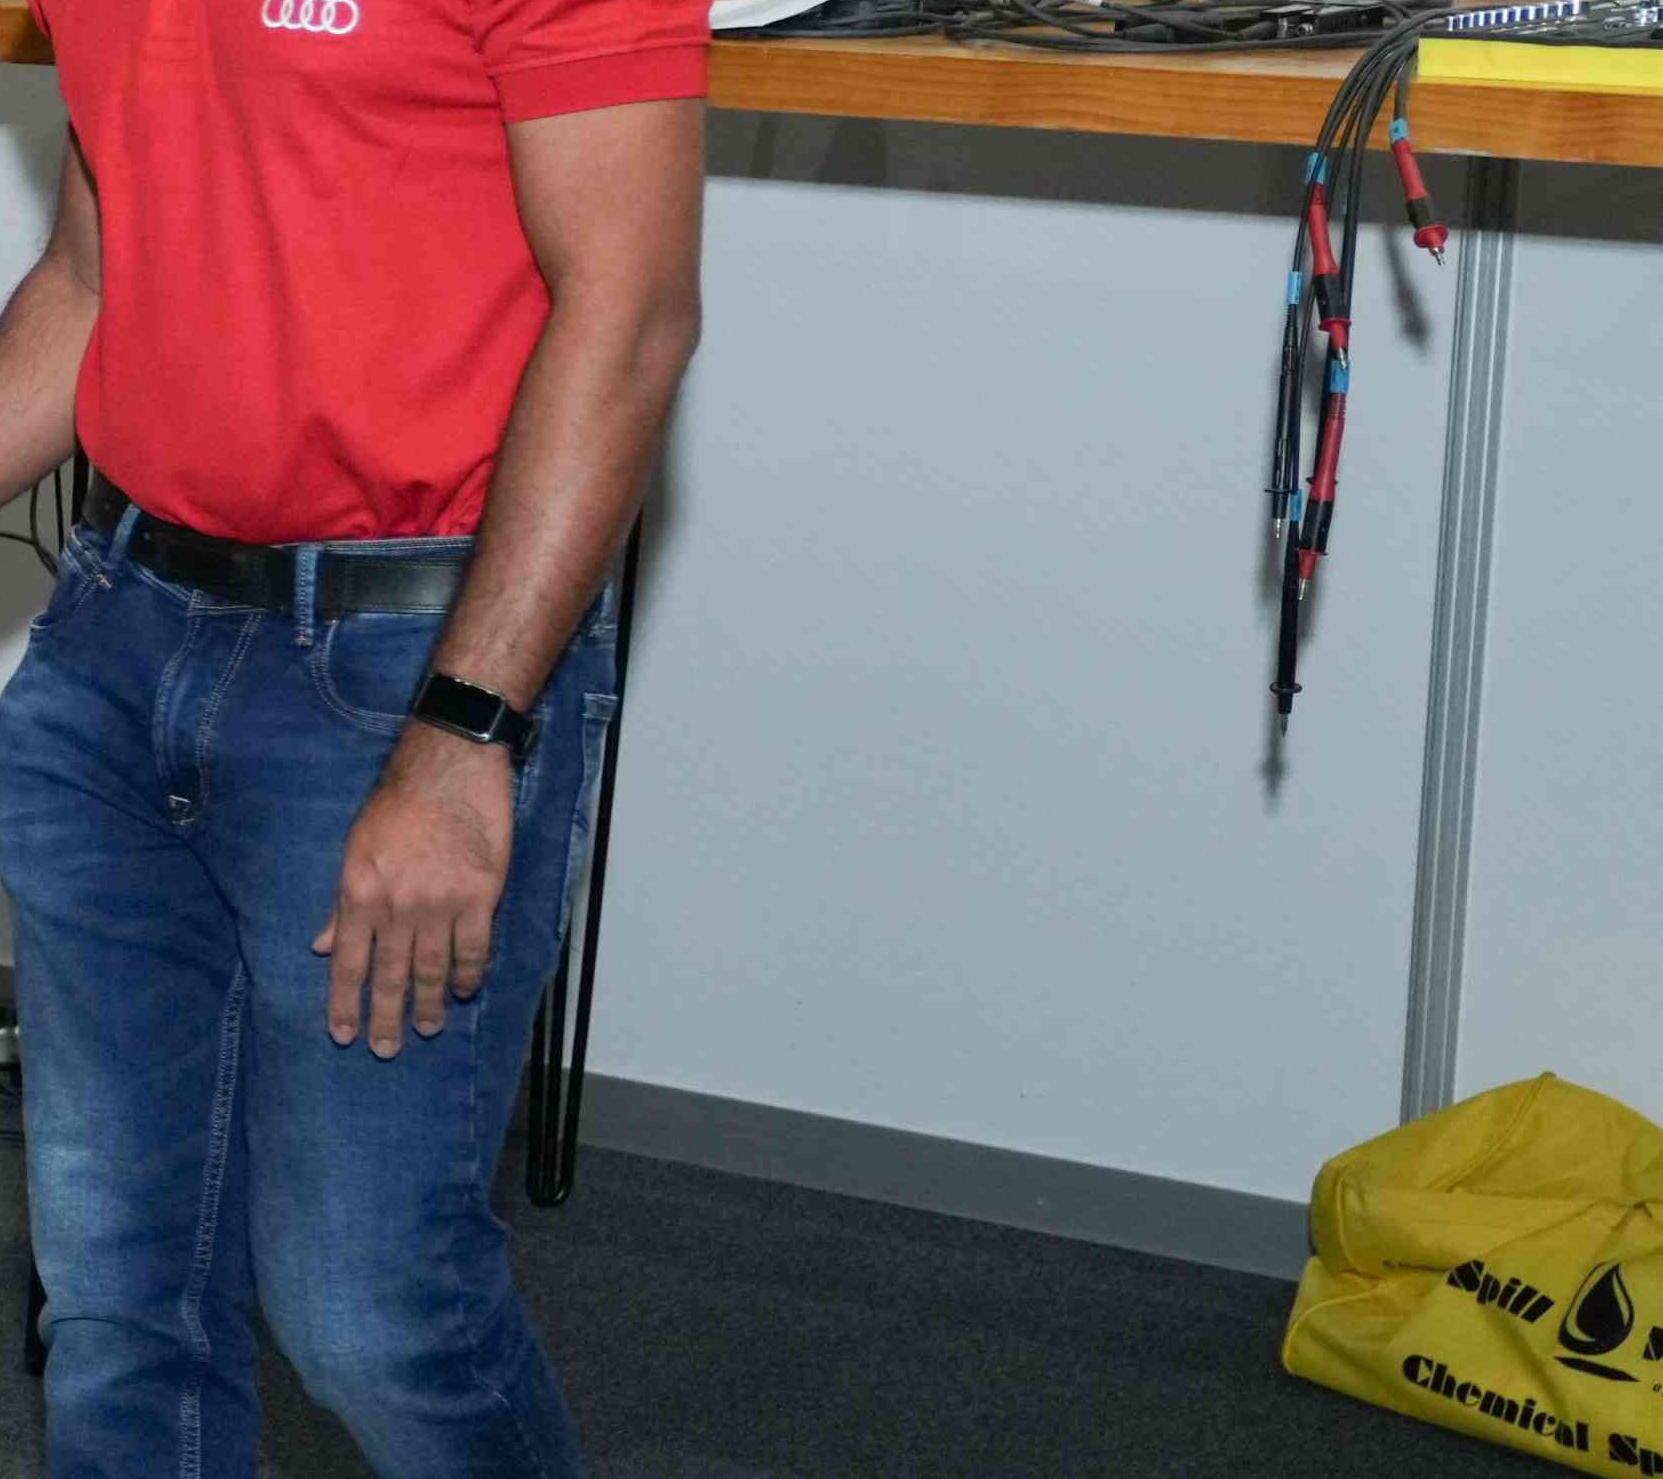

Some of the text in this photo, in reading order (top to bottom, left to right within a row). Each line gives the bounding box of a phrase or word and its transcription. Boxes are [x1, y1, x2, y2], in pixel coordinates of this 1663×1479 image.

[1446, 1259, 1556, 1324] Spill
[1400, 1353, 1663, 1478] Chemical Sp
